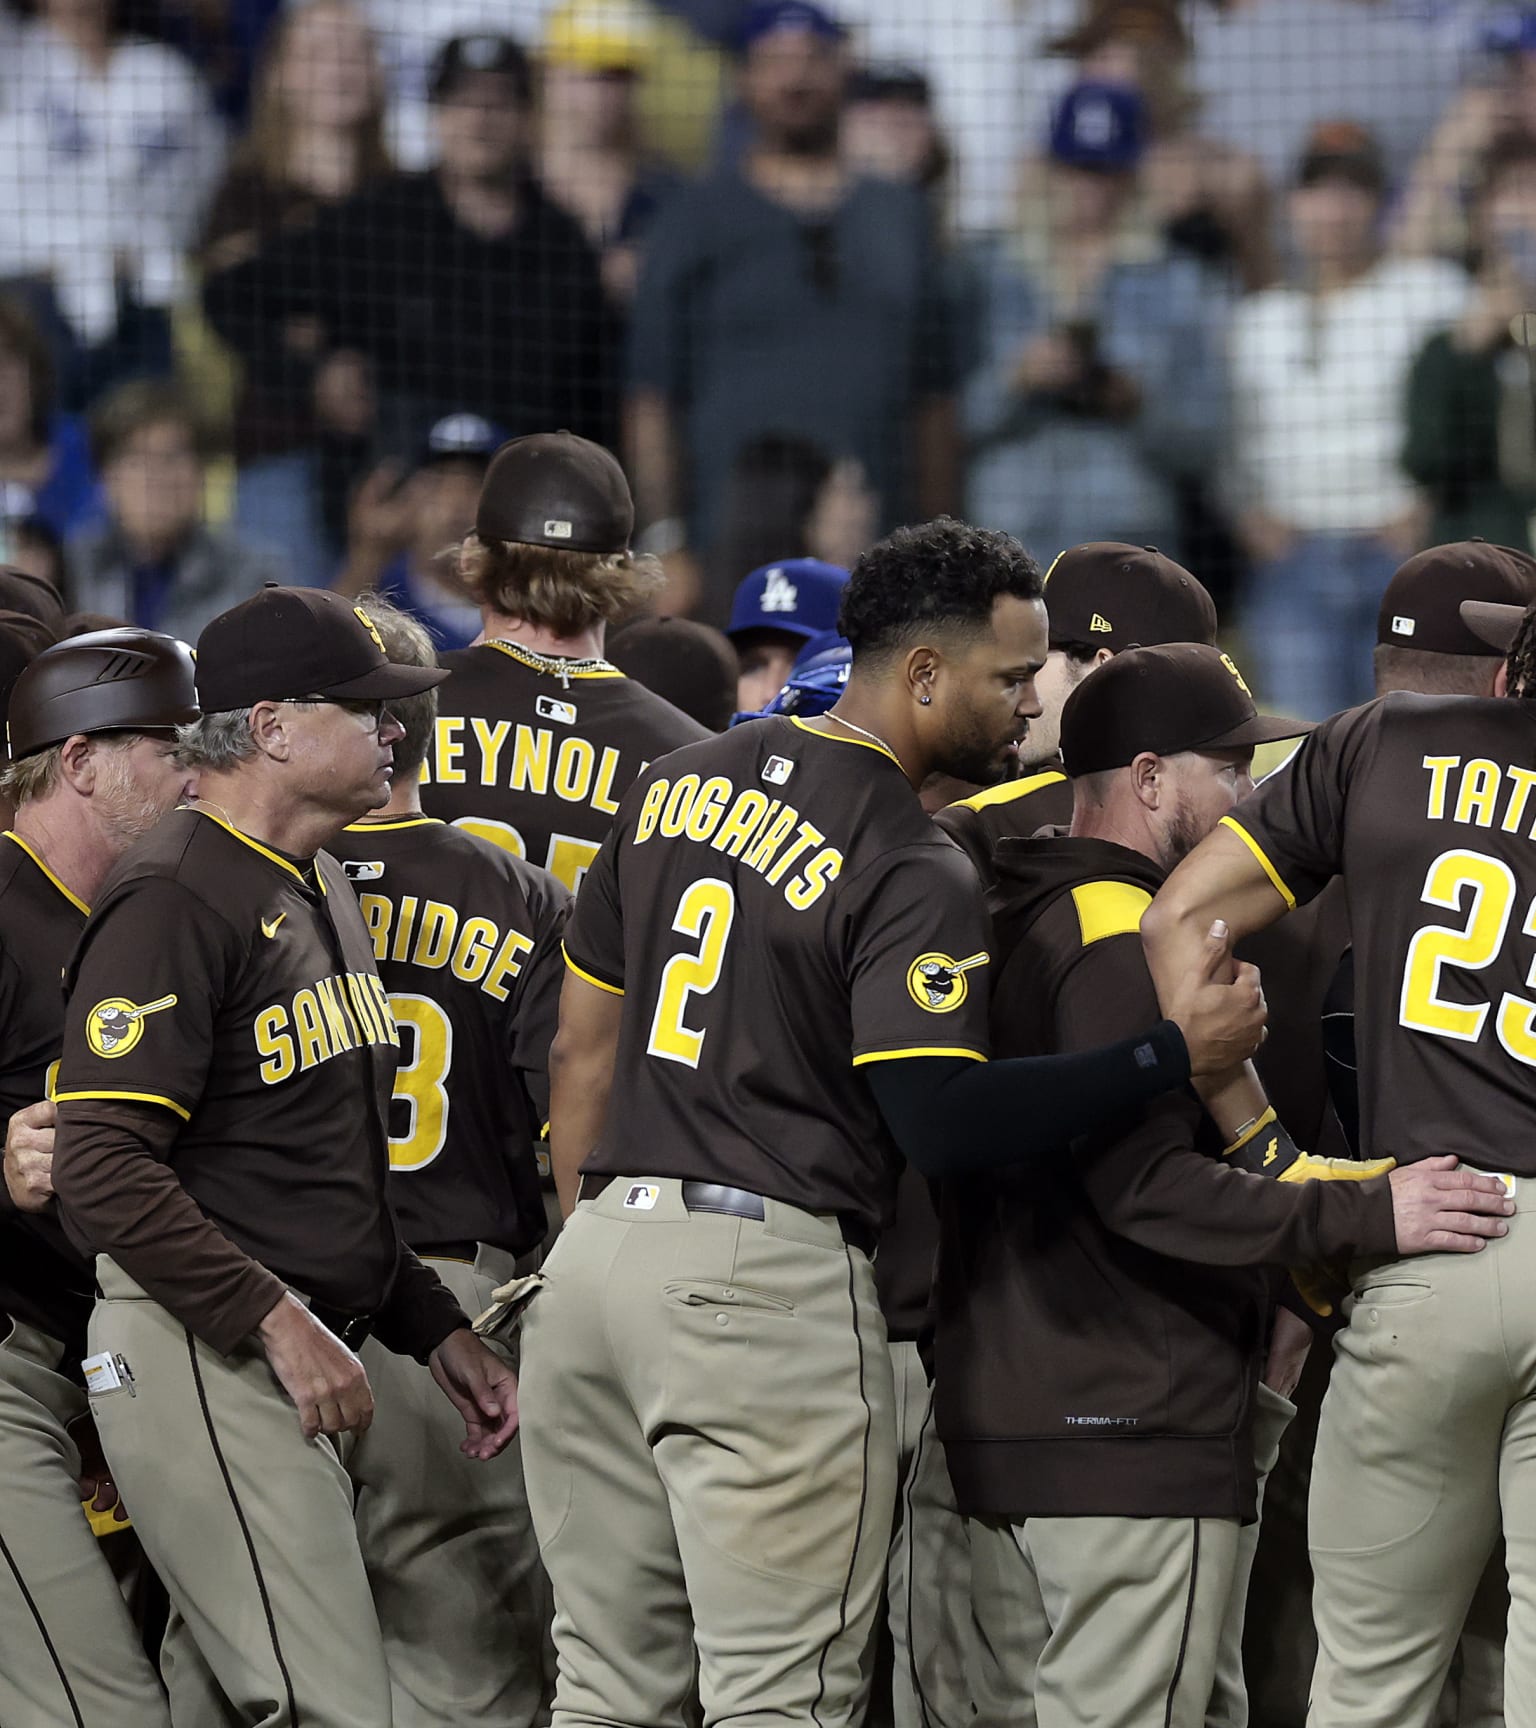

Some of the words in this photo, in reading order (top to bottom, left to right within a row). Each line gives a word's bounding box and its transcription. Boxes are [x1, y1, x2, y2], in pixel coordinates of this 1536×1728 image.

[418, 716, 650, 815] EYNOL
[633, 774, 844, 911] BOGAERTS
[359, 893, 535, 1002] RIDGE
[647, 877, 735, 1070] 2
[254, 976, 354, 1085] SAN
[334, 972, 400, 1049] DIE
[387, 992, 453, 1172] 3
[1064, 1416, 1139, 1426] THERMA-FIT
